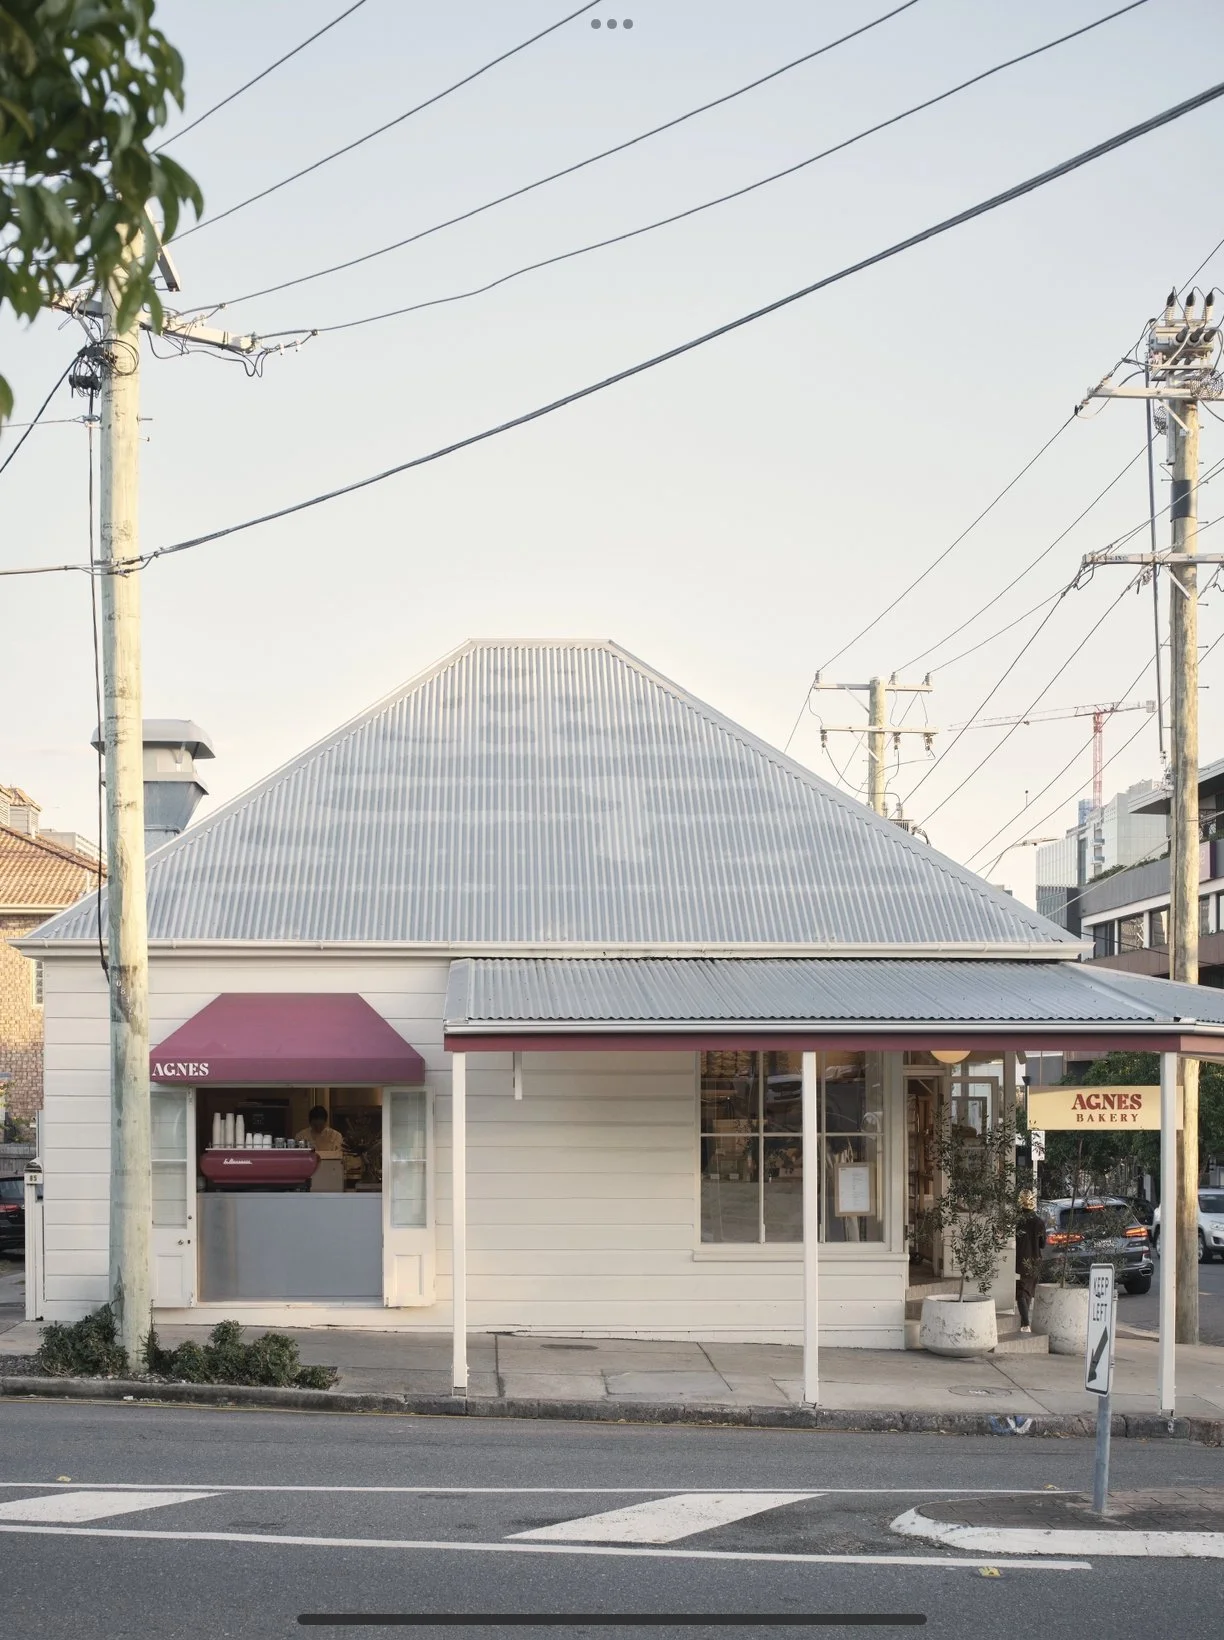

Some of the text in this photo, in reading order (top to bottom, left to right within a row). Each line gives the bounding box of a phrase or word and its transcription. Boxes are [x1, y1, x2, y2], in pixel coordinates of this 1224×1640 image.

[152, 1062, 209, 1077] AGNES
[1071, 1093, 1142, 1111] AGNES
[1076, 1113, 1138, 1122] BAKERY
[1093, 1276, 1109, 1296] KEEP
[1092, 1302, 1107, 1321] LEFT
